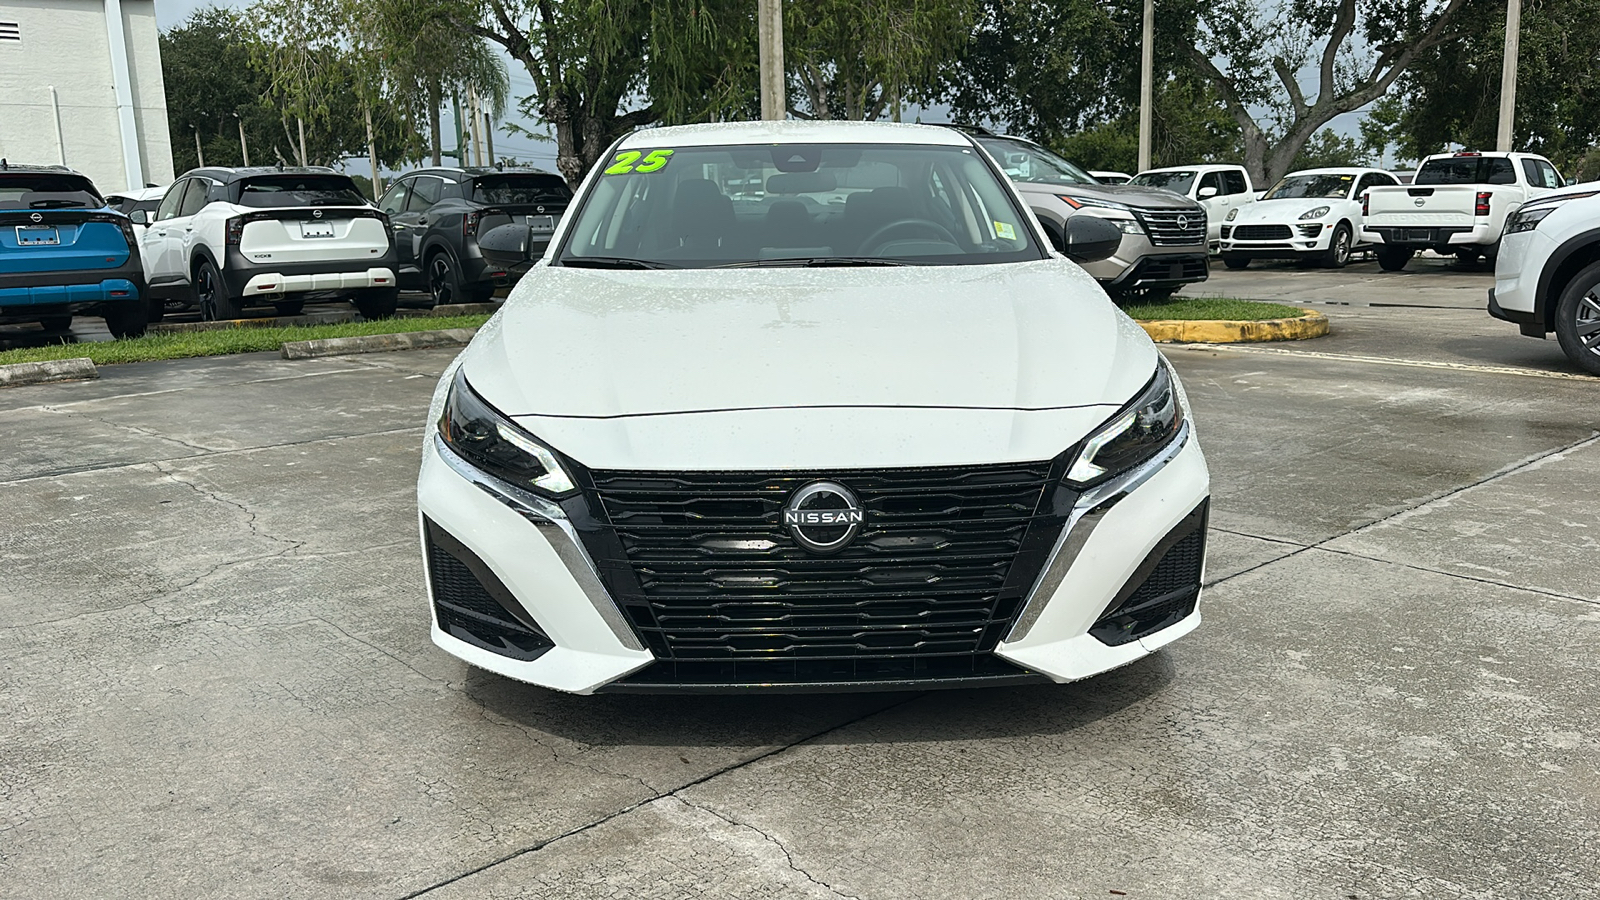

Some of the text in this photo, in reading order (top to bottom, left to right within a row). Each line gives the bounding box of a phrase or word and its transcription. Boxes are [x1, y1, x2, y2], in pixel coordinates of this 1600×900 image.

[604, 149, 674, 175] 25
[1376, 215, 1466, 223] FRONTIER
[785, 510, 863, 524] NISSAN
